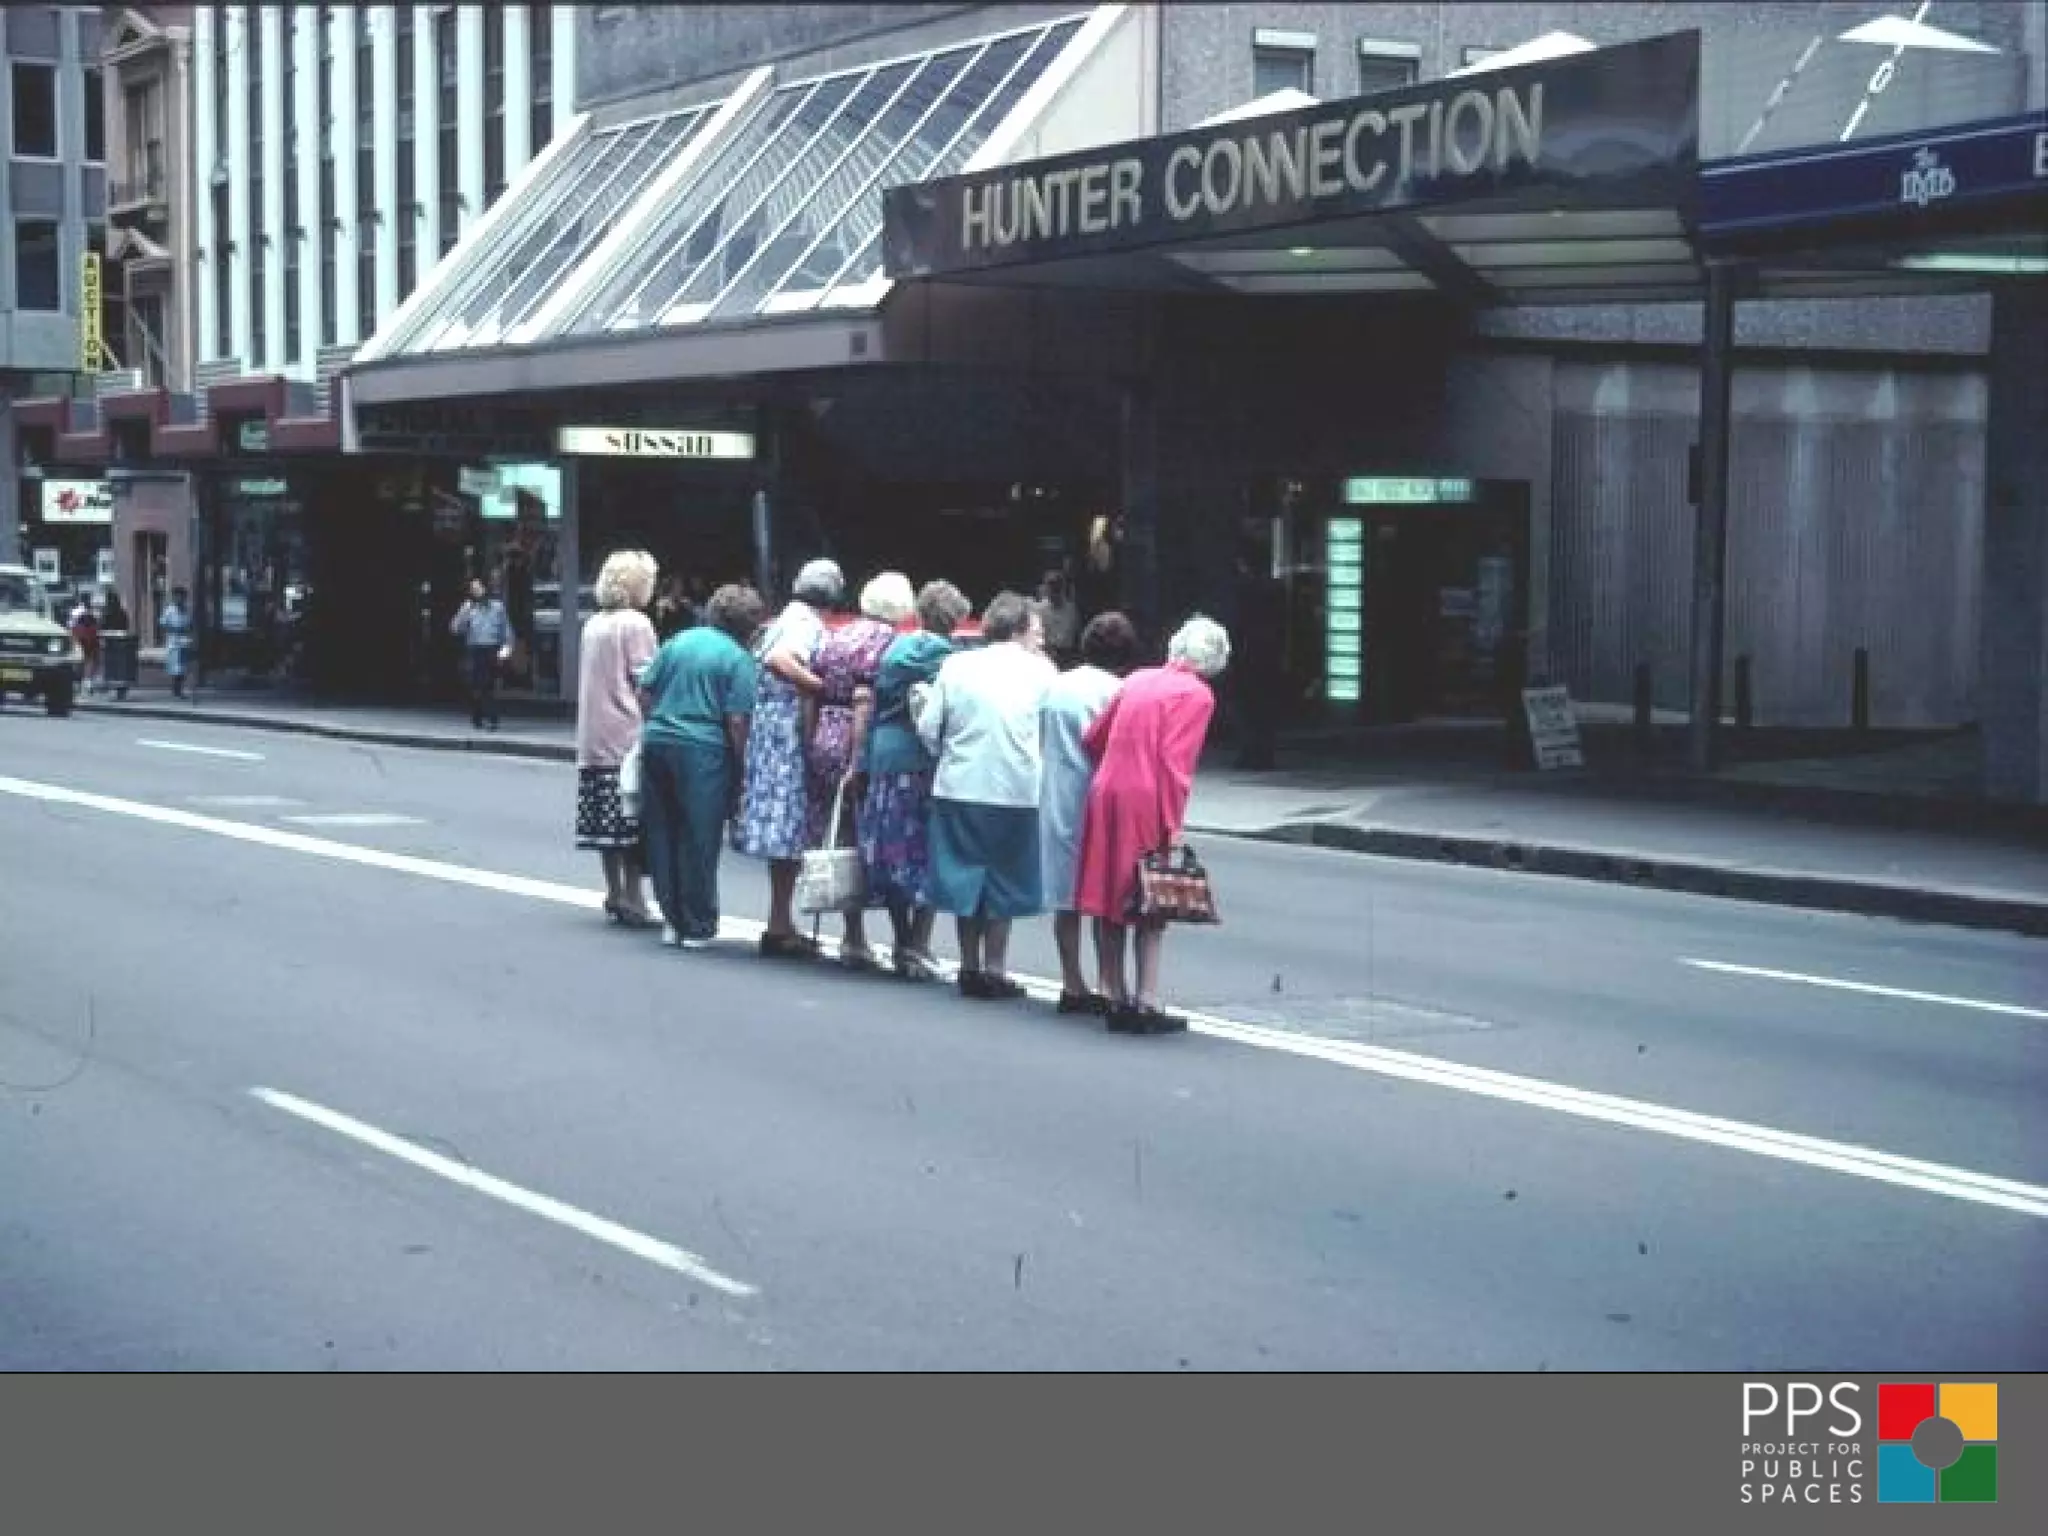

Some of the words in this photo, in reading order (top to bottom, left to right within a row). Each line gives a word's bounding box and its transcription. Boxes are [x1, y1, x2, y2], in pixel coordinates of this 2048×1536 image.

[962, 158, 1144, 247] HUNTER
[1164, 83, 1543, 220] CONNECTION
[83, 256, 98, 369] AUCTION
[604, 432, 713, 453] sussan
